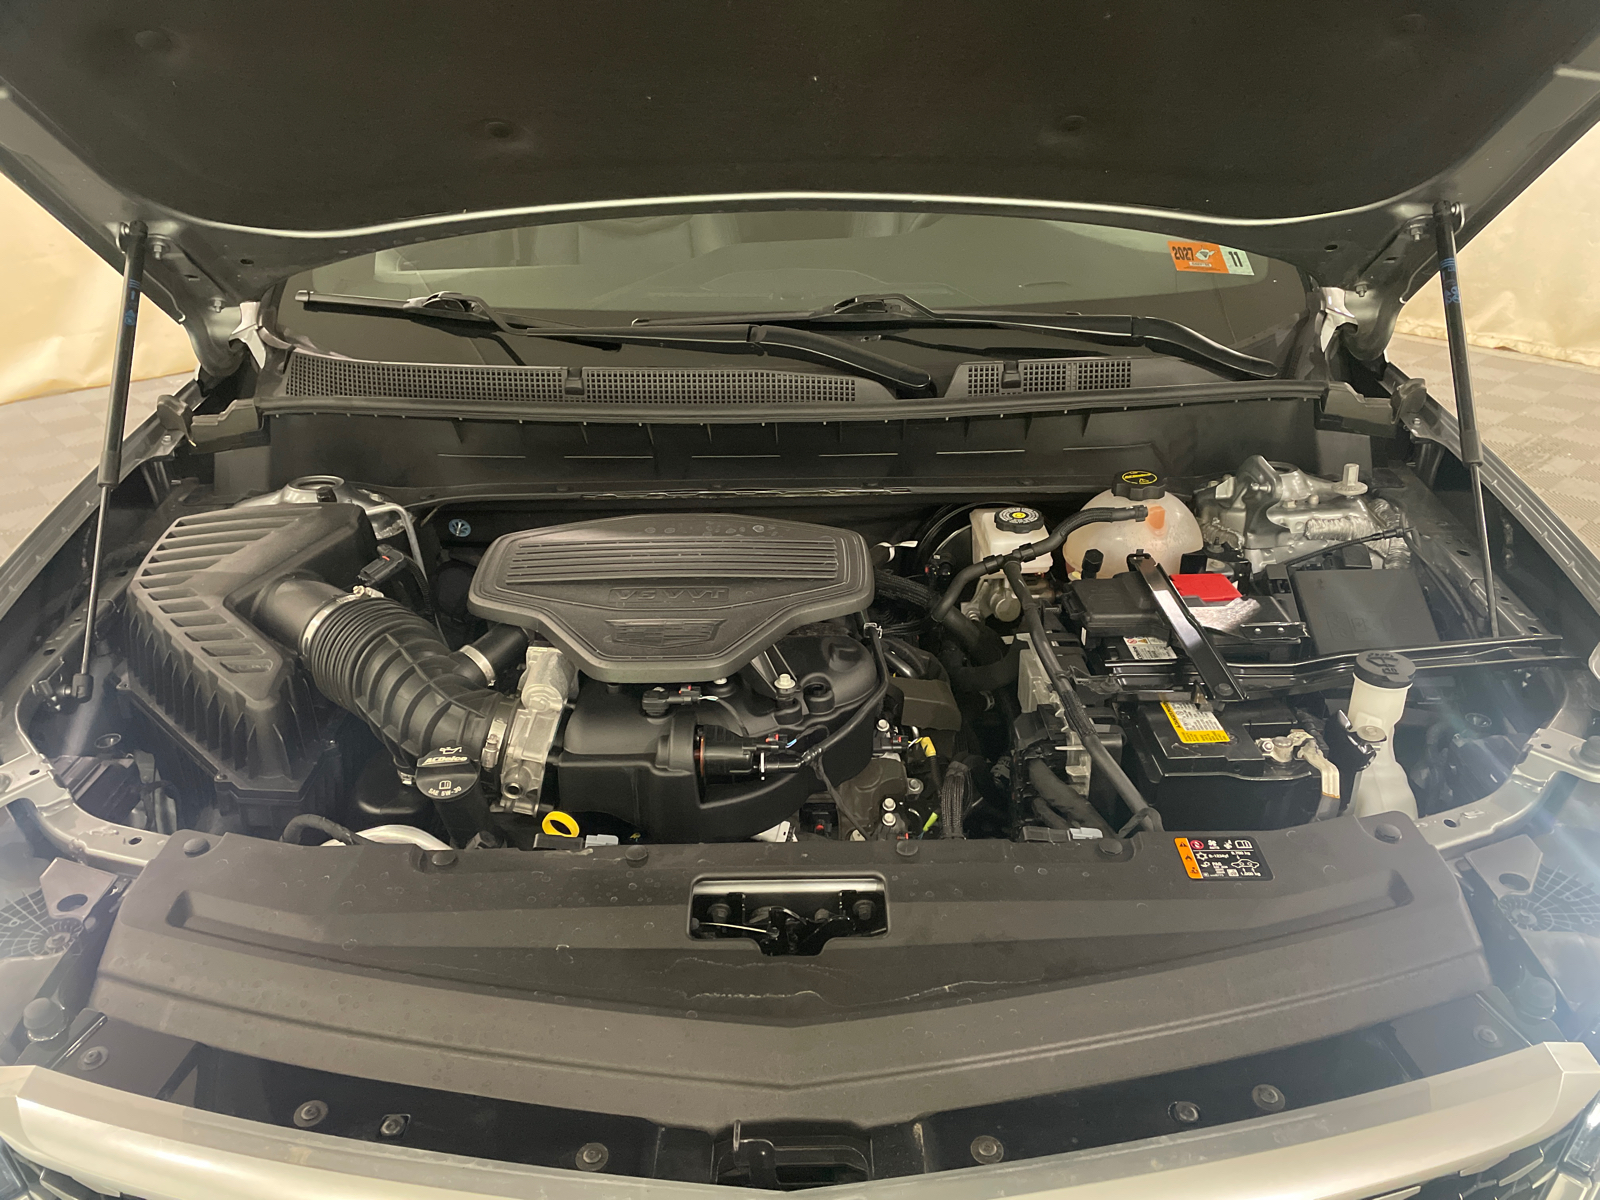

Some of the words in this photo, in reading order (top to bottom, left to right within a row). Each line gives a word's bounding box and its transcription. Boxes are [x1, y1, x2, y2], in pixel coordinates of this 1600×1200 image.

[1171, 246, 1195, 261] 2027
[1228, 251, 1244, 268] 11
[615, 589, 657, 600] V6
[662, 589, 726, 600] VVT
[422, 755, 468, 766] ACDelco
[428, 787, 439, 796] SAE
[441, 785, 462, 797] 5W-30
